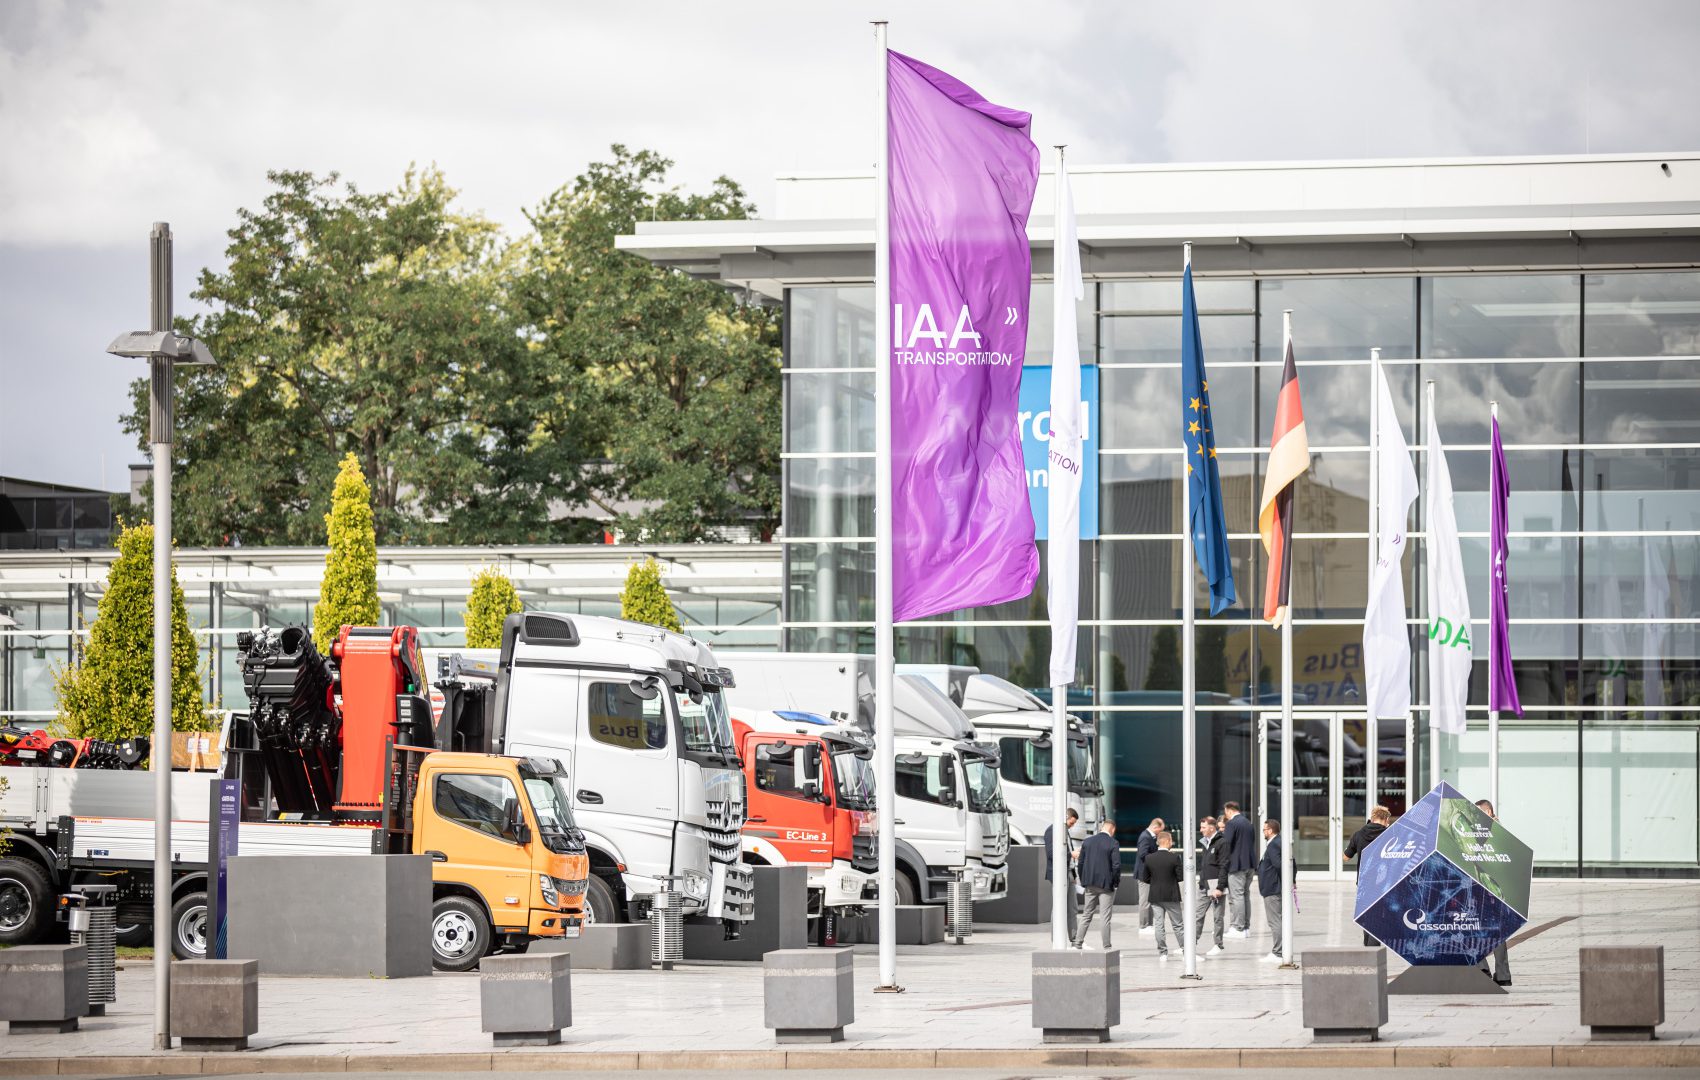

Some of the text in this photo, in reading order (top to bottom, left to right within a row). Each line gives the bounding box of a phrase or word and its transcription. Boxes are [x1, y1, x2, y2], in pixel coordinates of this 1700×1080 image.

[894, 303, 982, 349] IAA
[894, 351, 1012, 366] TRANSPORTATION
[786, 831, 828, 841] EC-Line 3
